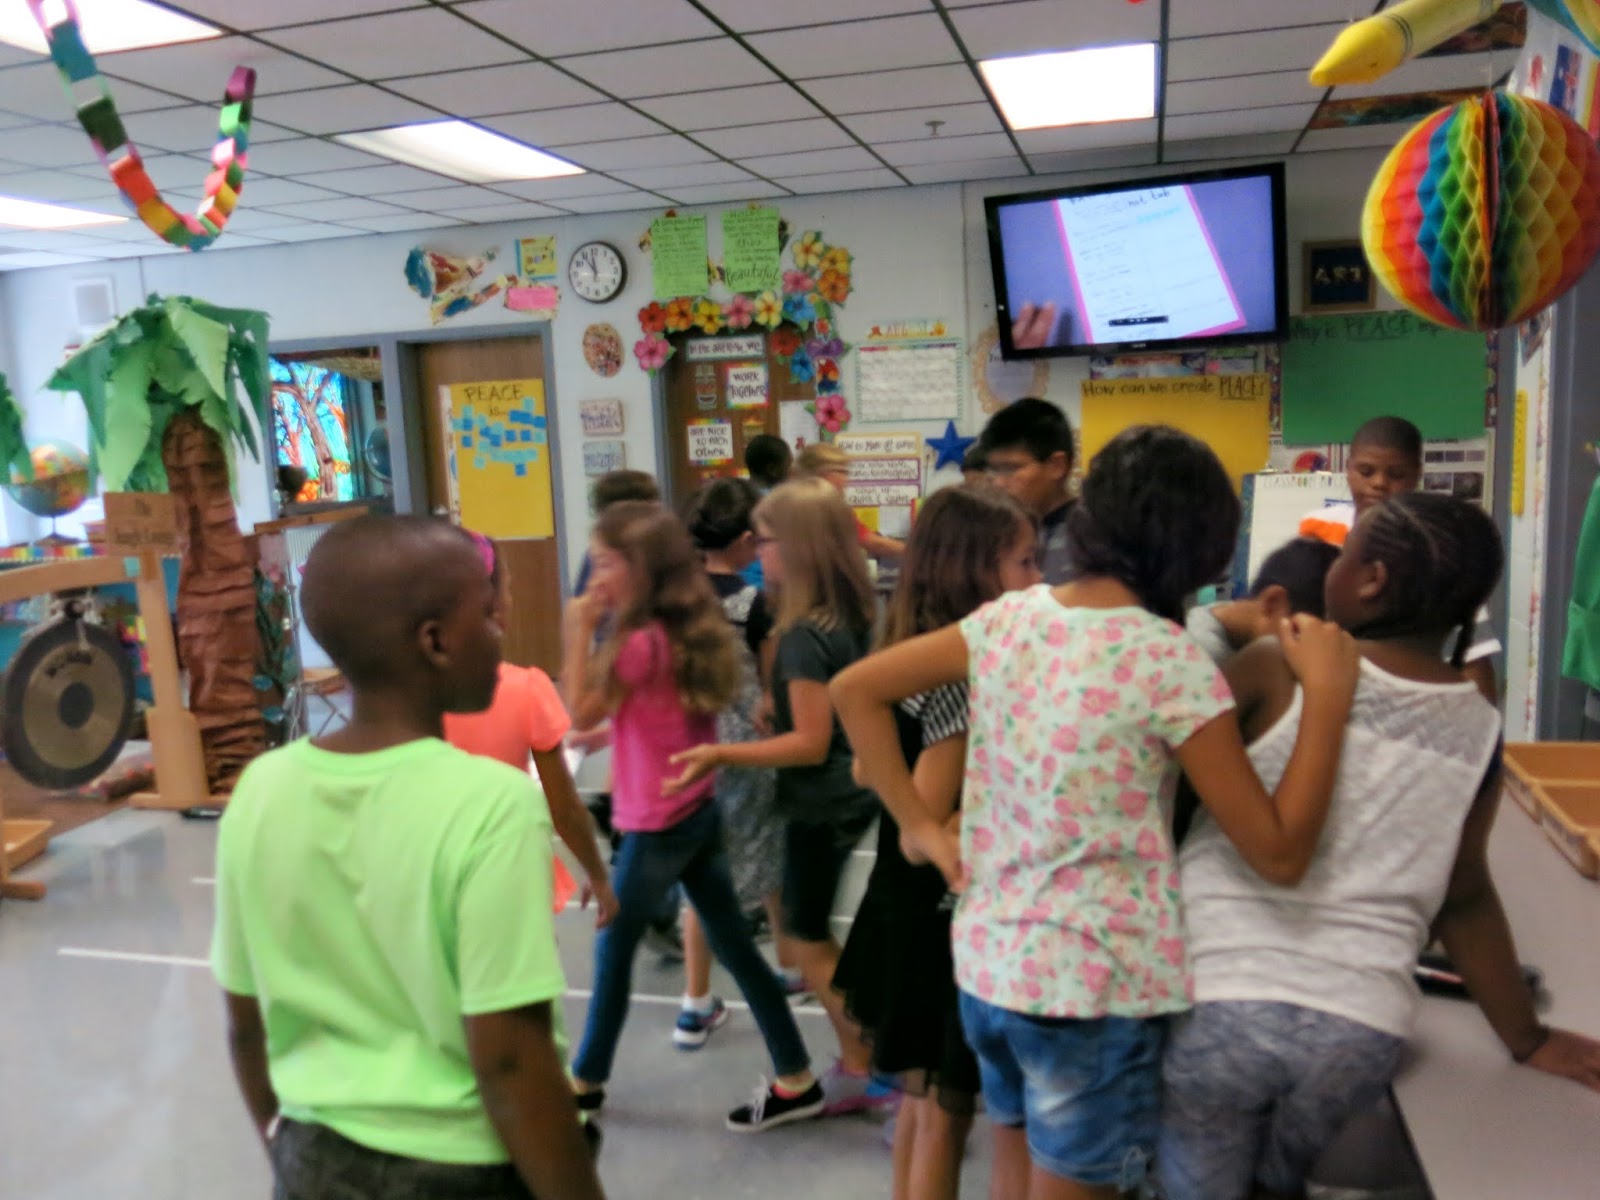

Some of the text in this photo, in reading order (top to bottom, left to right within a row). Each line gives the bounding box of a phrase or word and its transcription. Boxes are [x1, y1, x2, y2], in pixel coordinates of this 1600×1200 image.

[1314, 265, 1362, 285] ART
[463, 384, 523, 403] PEACE
[1081, 379, 1116, 397] How
[1121, 380, 1146, 395] can
[1151, 380, 1170, 393] we
[1173, 376, 1216, 394] create
